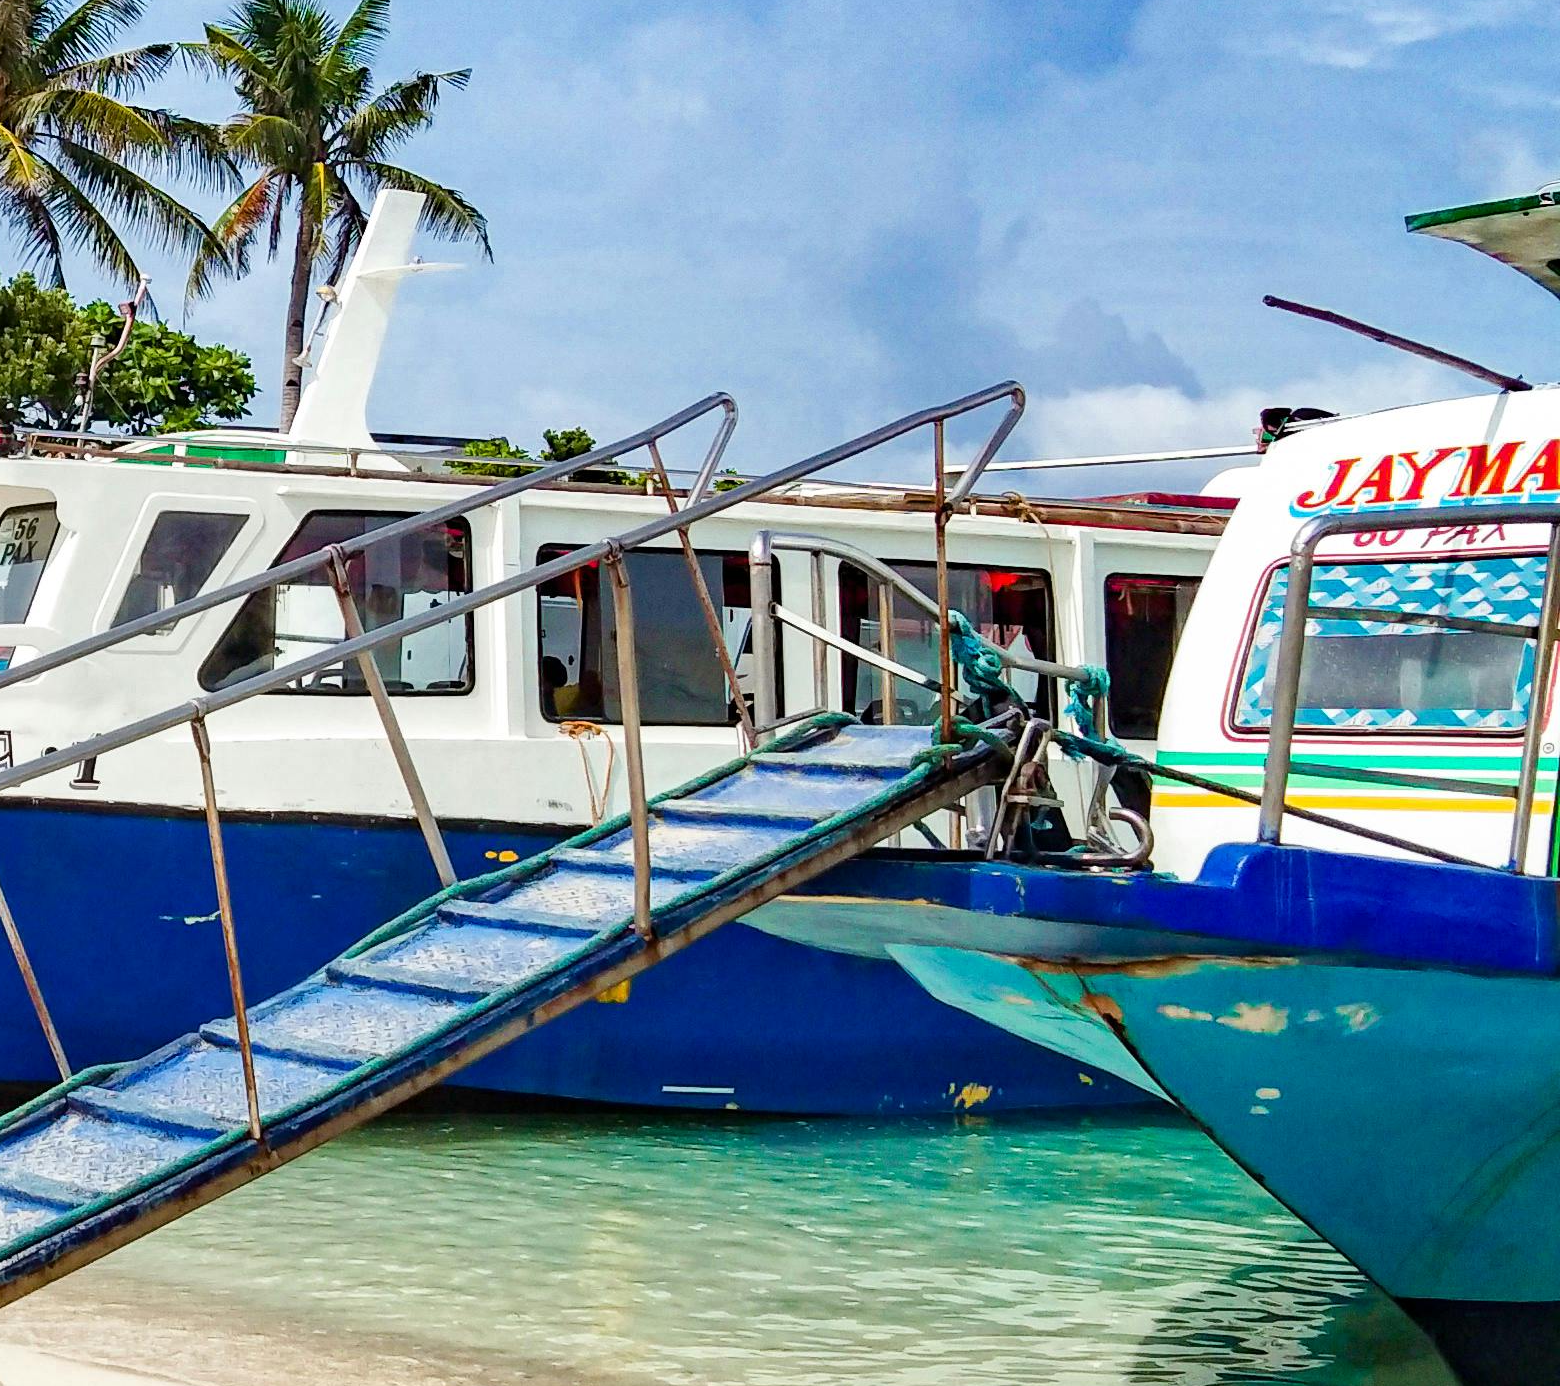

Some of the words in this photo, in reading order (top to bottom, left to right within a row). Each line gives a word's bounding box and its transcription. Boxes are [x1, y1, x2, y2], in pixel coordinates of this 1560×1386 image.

[1291, 438, 1560, 516] JAYMA
[14, 517, 39, 541] 56
[0, 540, 38, 566] PAX
